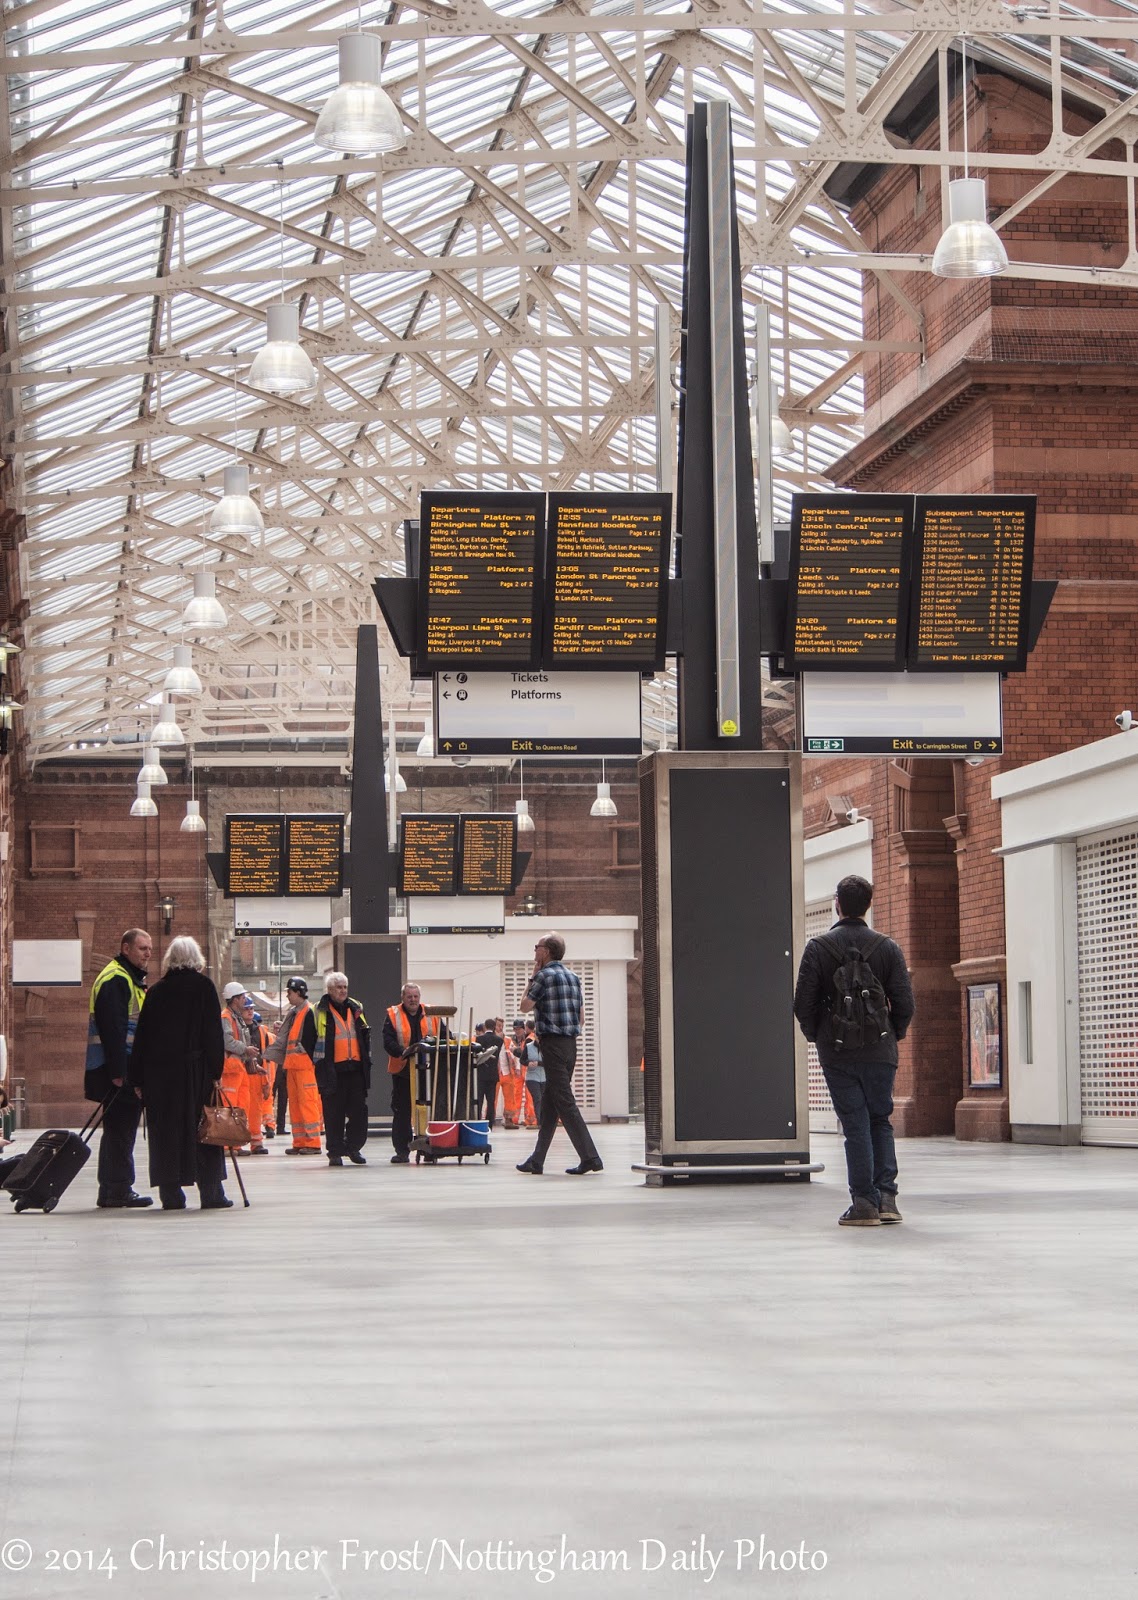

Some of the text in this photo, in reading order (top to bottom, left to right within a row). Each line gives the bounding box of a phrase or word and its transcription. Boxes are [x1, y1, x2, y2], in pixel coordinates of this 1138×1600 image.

[511, 673, 548, 682] Tickets
[511, 690, 561, 699] Platforms
[512, 740, 532, 750] Exit
[893, 740, 913, 749] Exit
